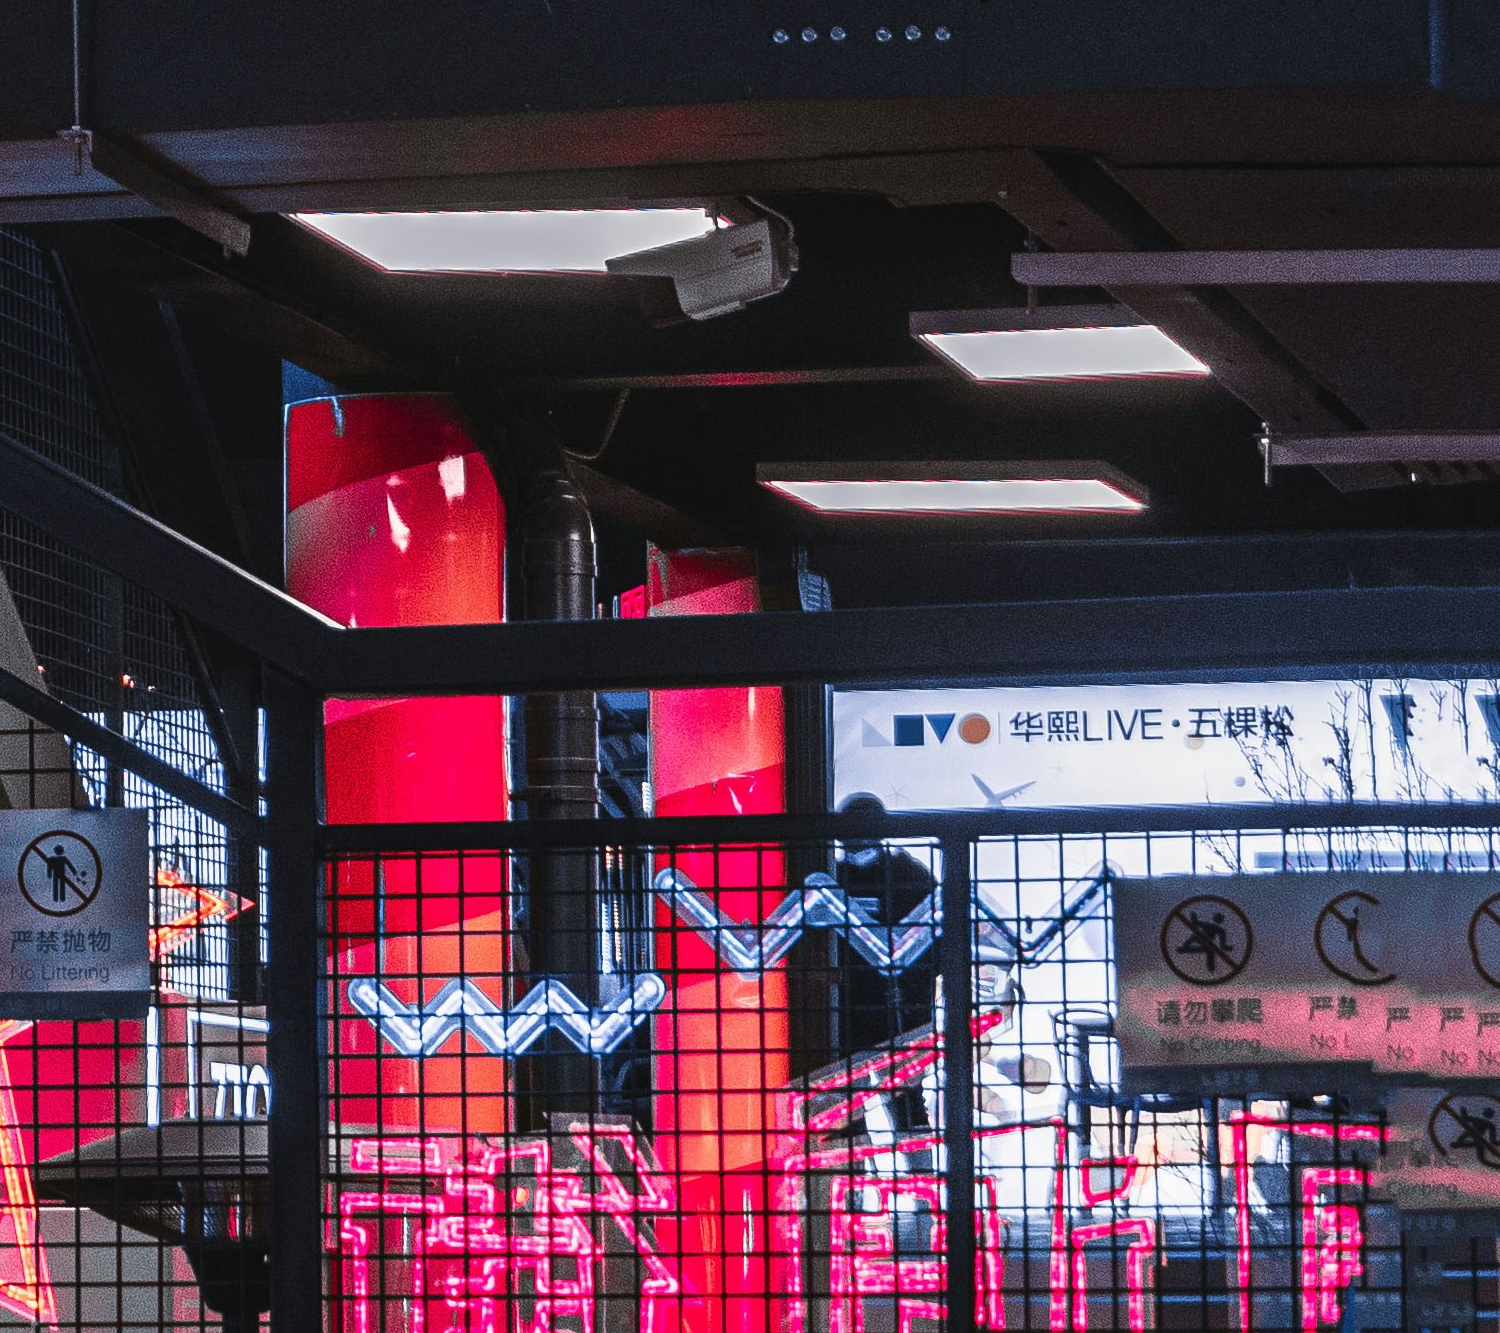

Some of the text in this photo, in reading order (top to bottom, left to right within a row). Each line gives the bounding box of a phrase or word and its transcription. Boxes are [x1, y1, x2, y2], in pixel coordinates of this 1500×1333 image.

[10, 929, 112, 953] 严禁抛物
[10, 966, 36, 981] No
[1157, 998, 1263, 1025] 请勿攀爬
